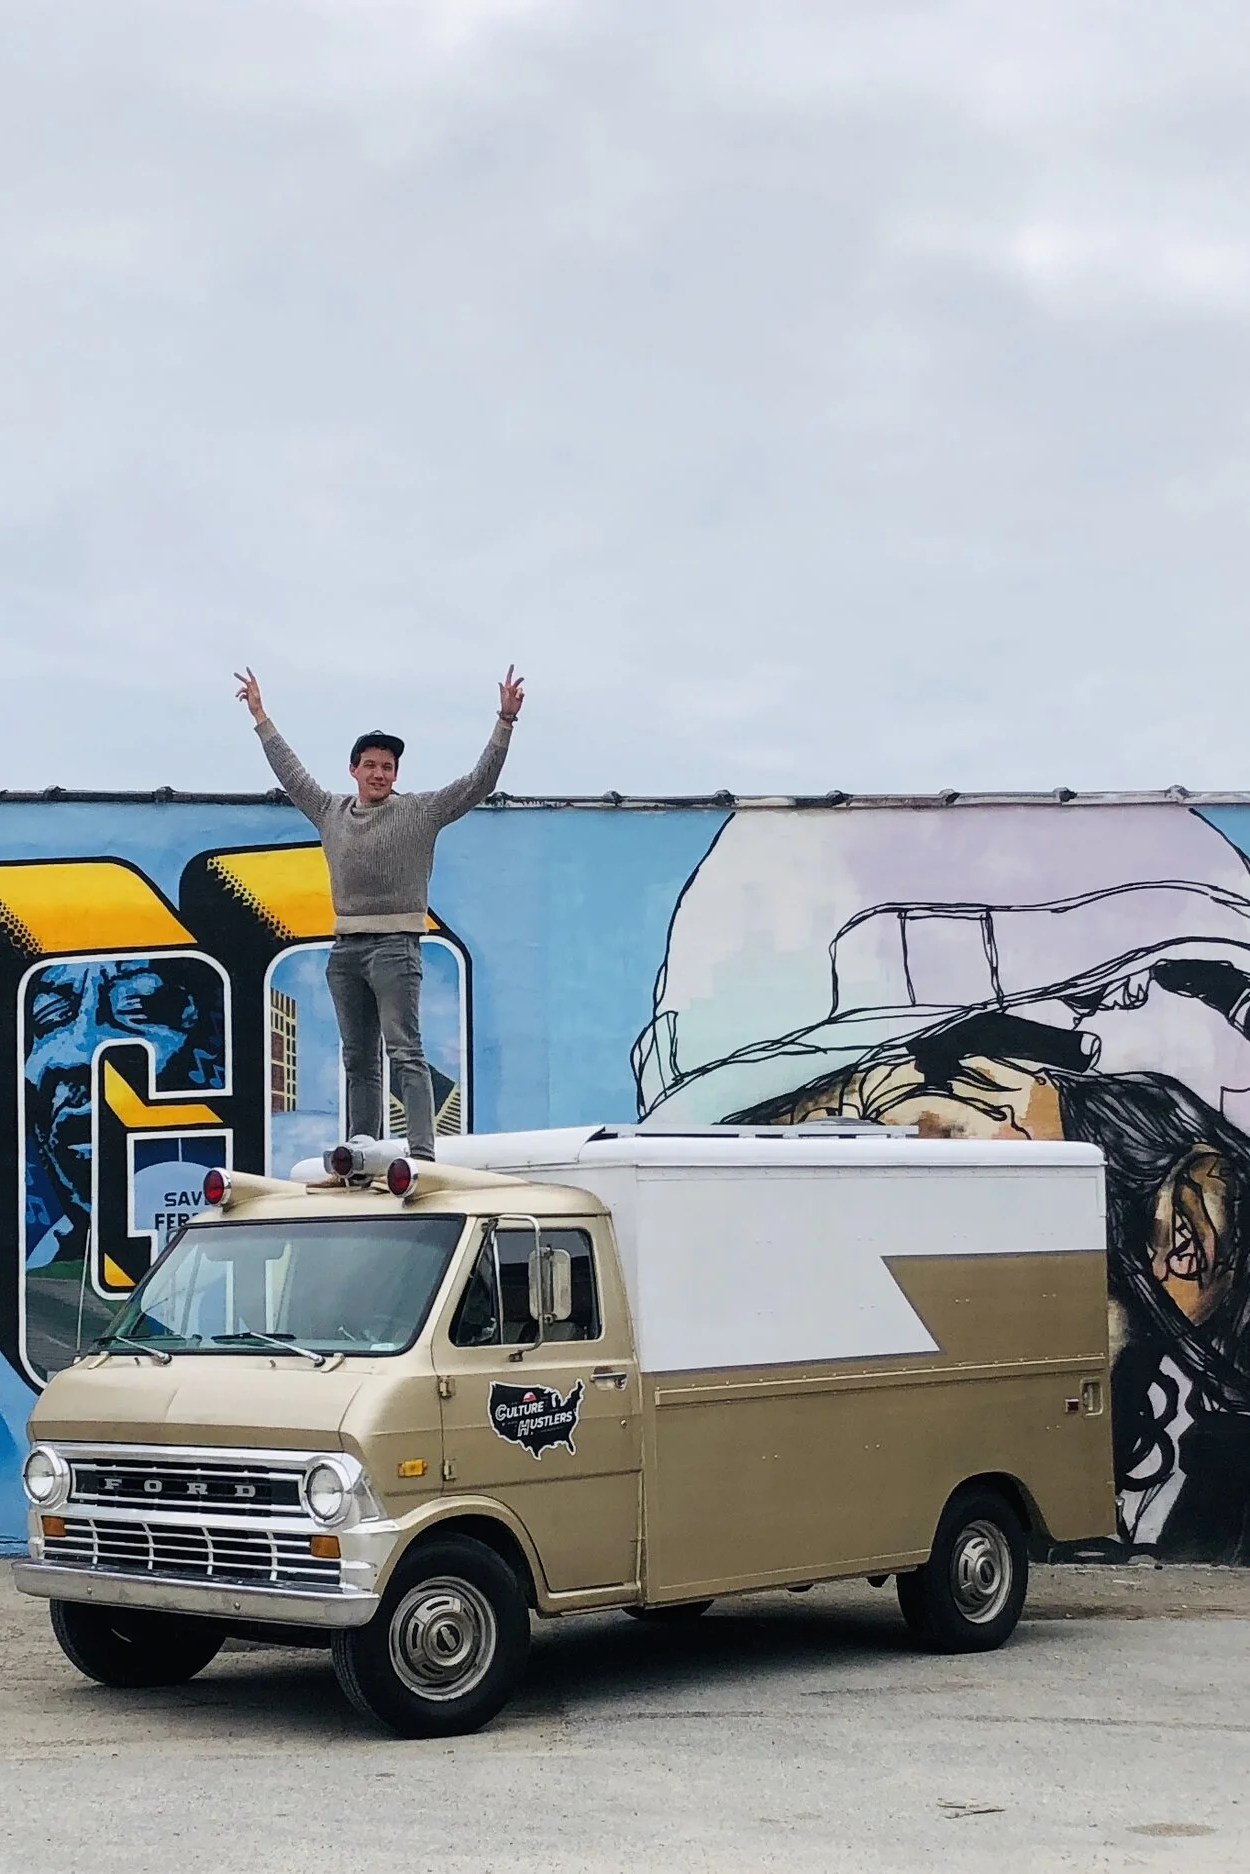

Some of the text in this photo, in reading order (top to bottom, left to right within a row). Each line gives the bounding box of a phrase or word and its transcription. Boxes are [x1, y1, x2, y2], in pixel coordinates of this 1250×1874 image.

[163, 1190, 212, 1208] SAV
[494, 1400, 546, 1422] CULTURE
[516, 1410, 574, 1438] HUSTLERS
[103, 1477, 257, 1499] FORD
